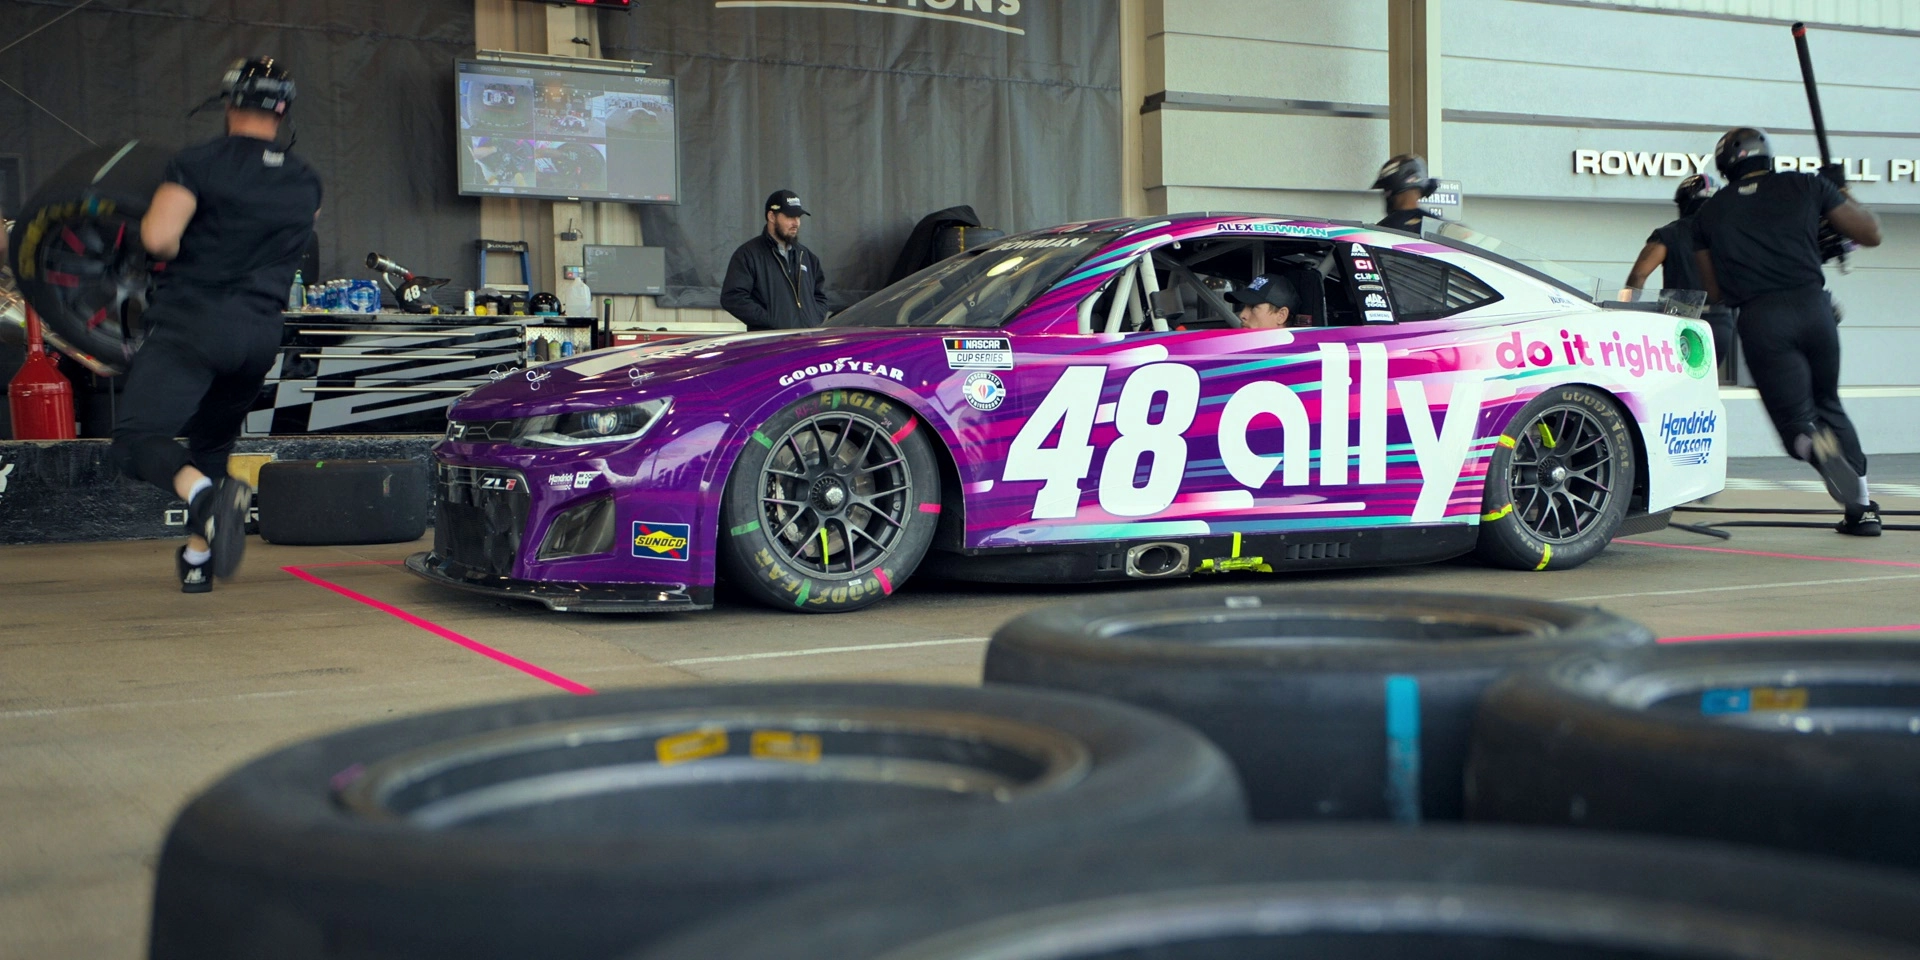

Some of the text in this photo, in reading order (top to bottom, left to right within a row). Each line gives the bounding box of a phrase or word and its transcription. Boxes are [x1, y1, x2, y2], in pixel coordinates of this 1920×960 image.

[1576, 150, 1712, 177] ROWDY
[990, 238, 1088, 252] BOWMAN
[403, 284, 421, 303] 48
[966, 340, 1000, 349] NASCAR
[1496, 331, 1553, 369] do
[1560, 329, 1595, 366] it
[1599, 331, 1683, 377] right.
[956, 353, 1003, 363] CUP SERIES
[779, 357, 904, 386] GOODYEAR
[1002, 342, 1484, 523] 48 ally
[1660, 411, 1717, 444] Hendrick
[1667, 437, 1712, 455] Cars.com
[637, 537, 685, 548] SUNOCO
